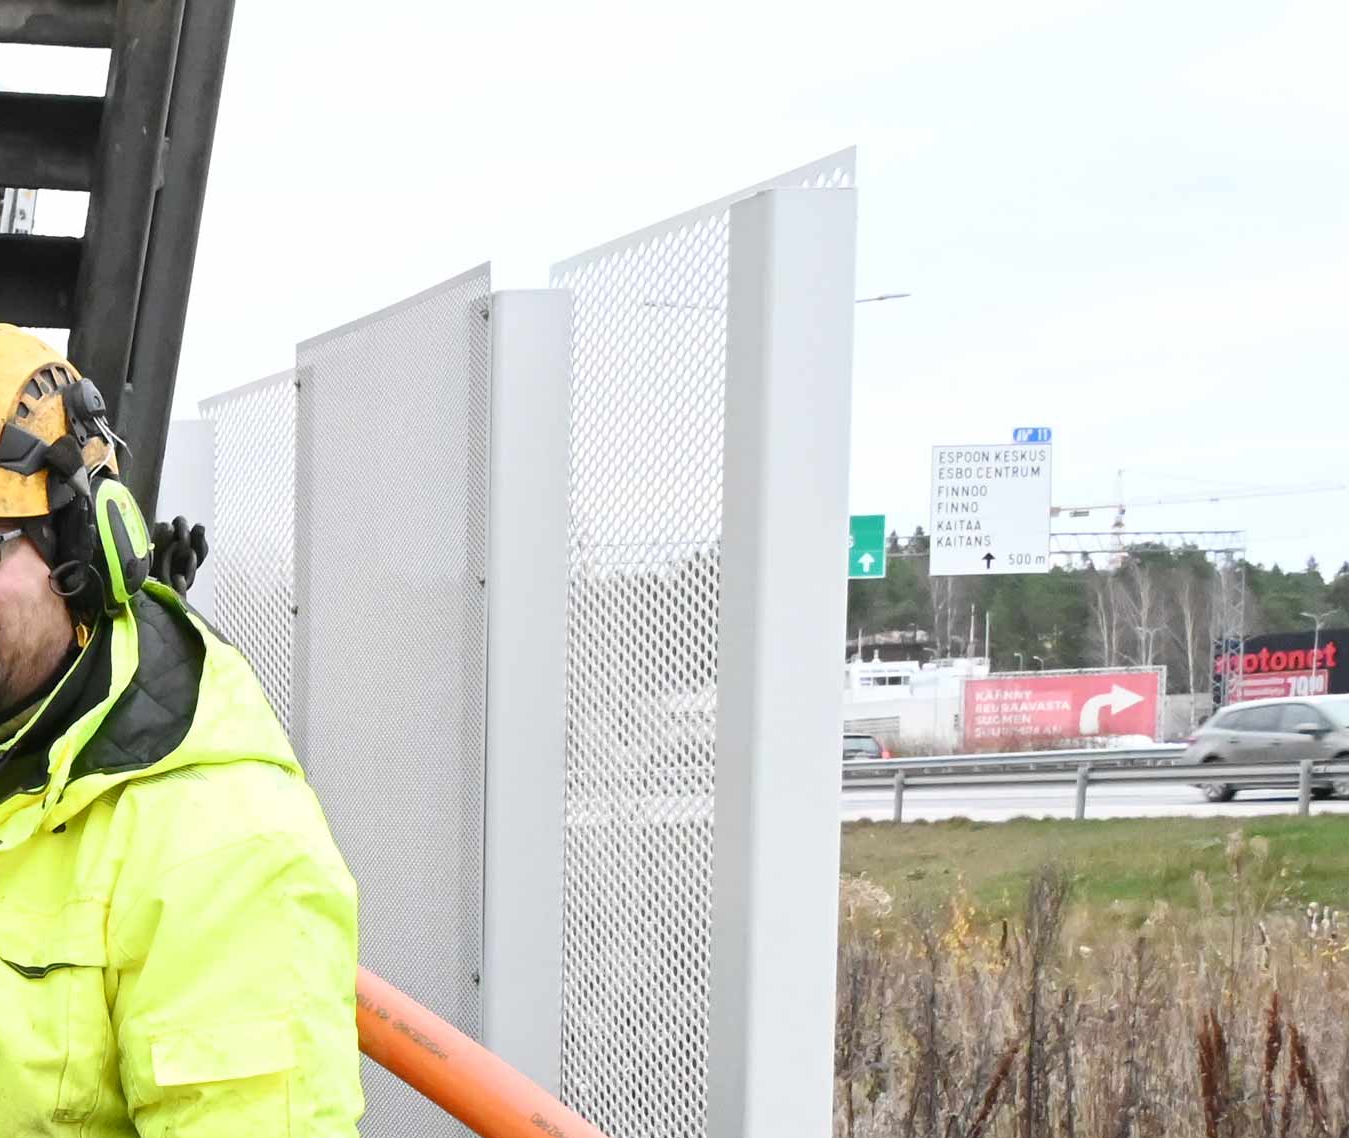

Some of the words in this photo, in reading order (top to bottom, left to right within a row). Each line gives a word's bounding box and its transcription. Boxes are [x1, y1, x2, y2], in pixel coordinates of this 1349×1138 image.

[939, 451, 990, 464] ESPOON
[995, 449, 1047, 462] KESKUS
[938, 467, 973, 480] ESBO
[976, 466, 1041, 479] CENTRUM
[937, 485, 988, 497] FINNOO
[937, 501, 979, 513] FINNO
[937, 520, 982, 531] KAITAA
[937, 535, 991, 548] KAITANS
[1008, 553, 1032, 566] 500
[1035, 555, 1046, 564] m
